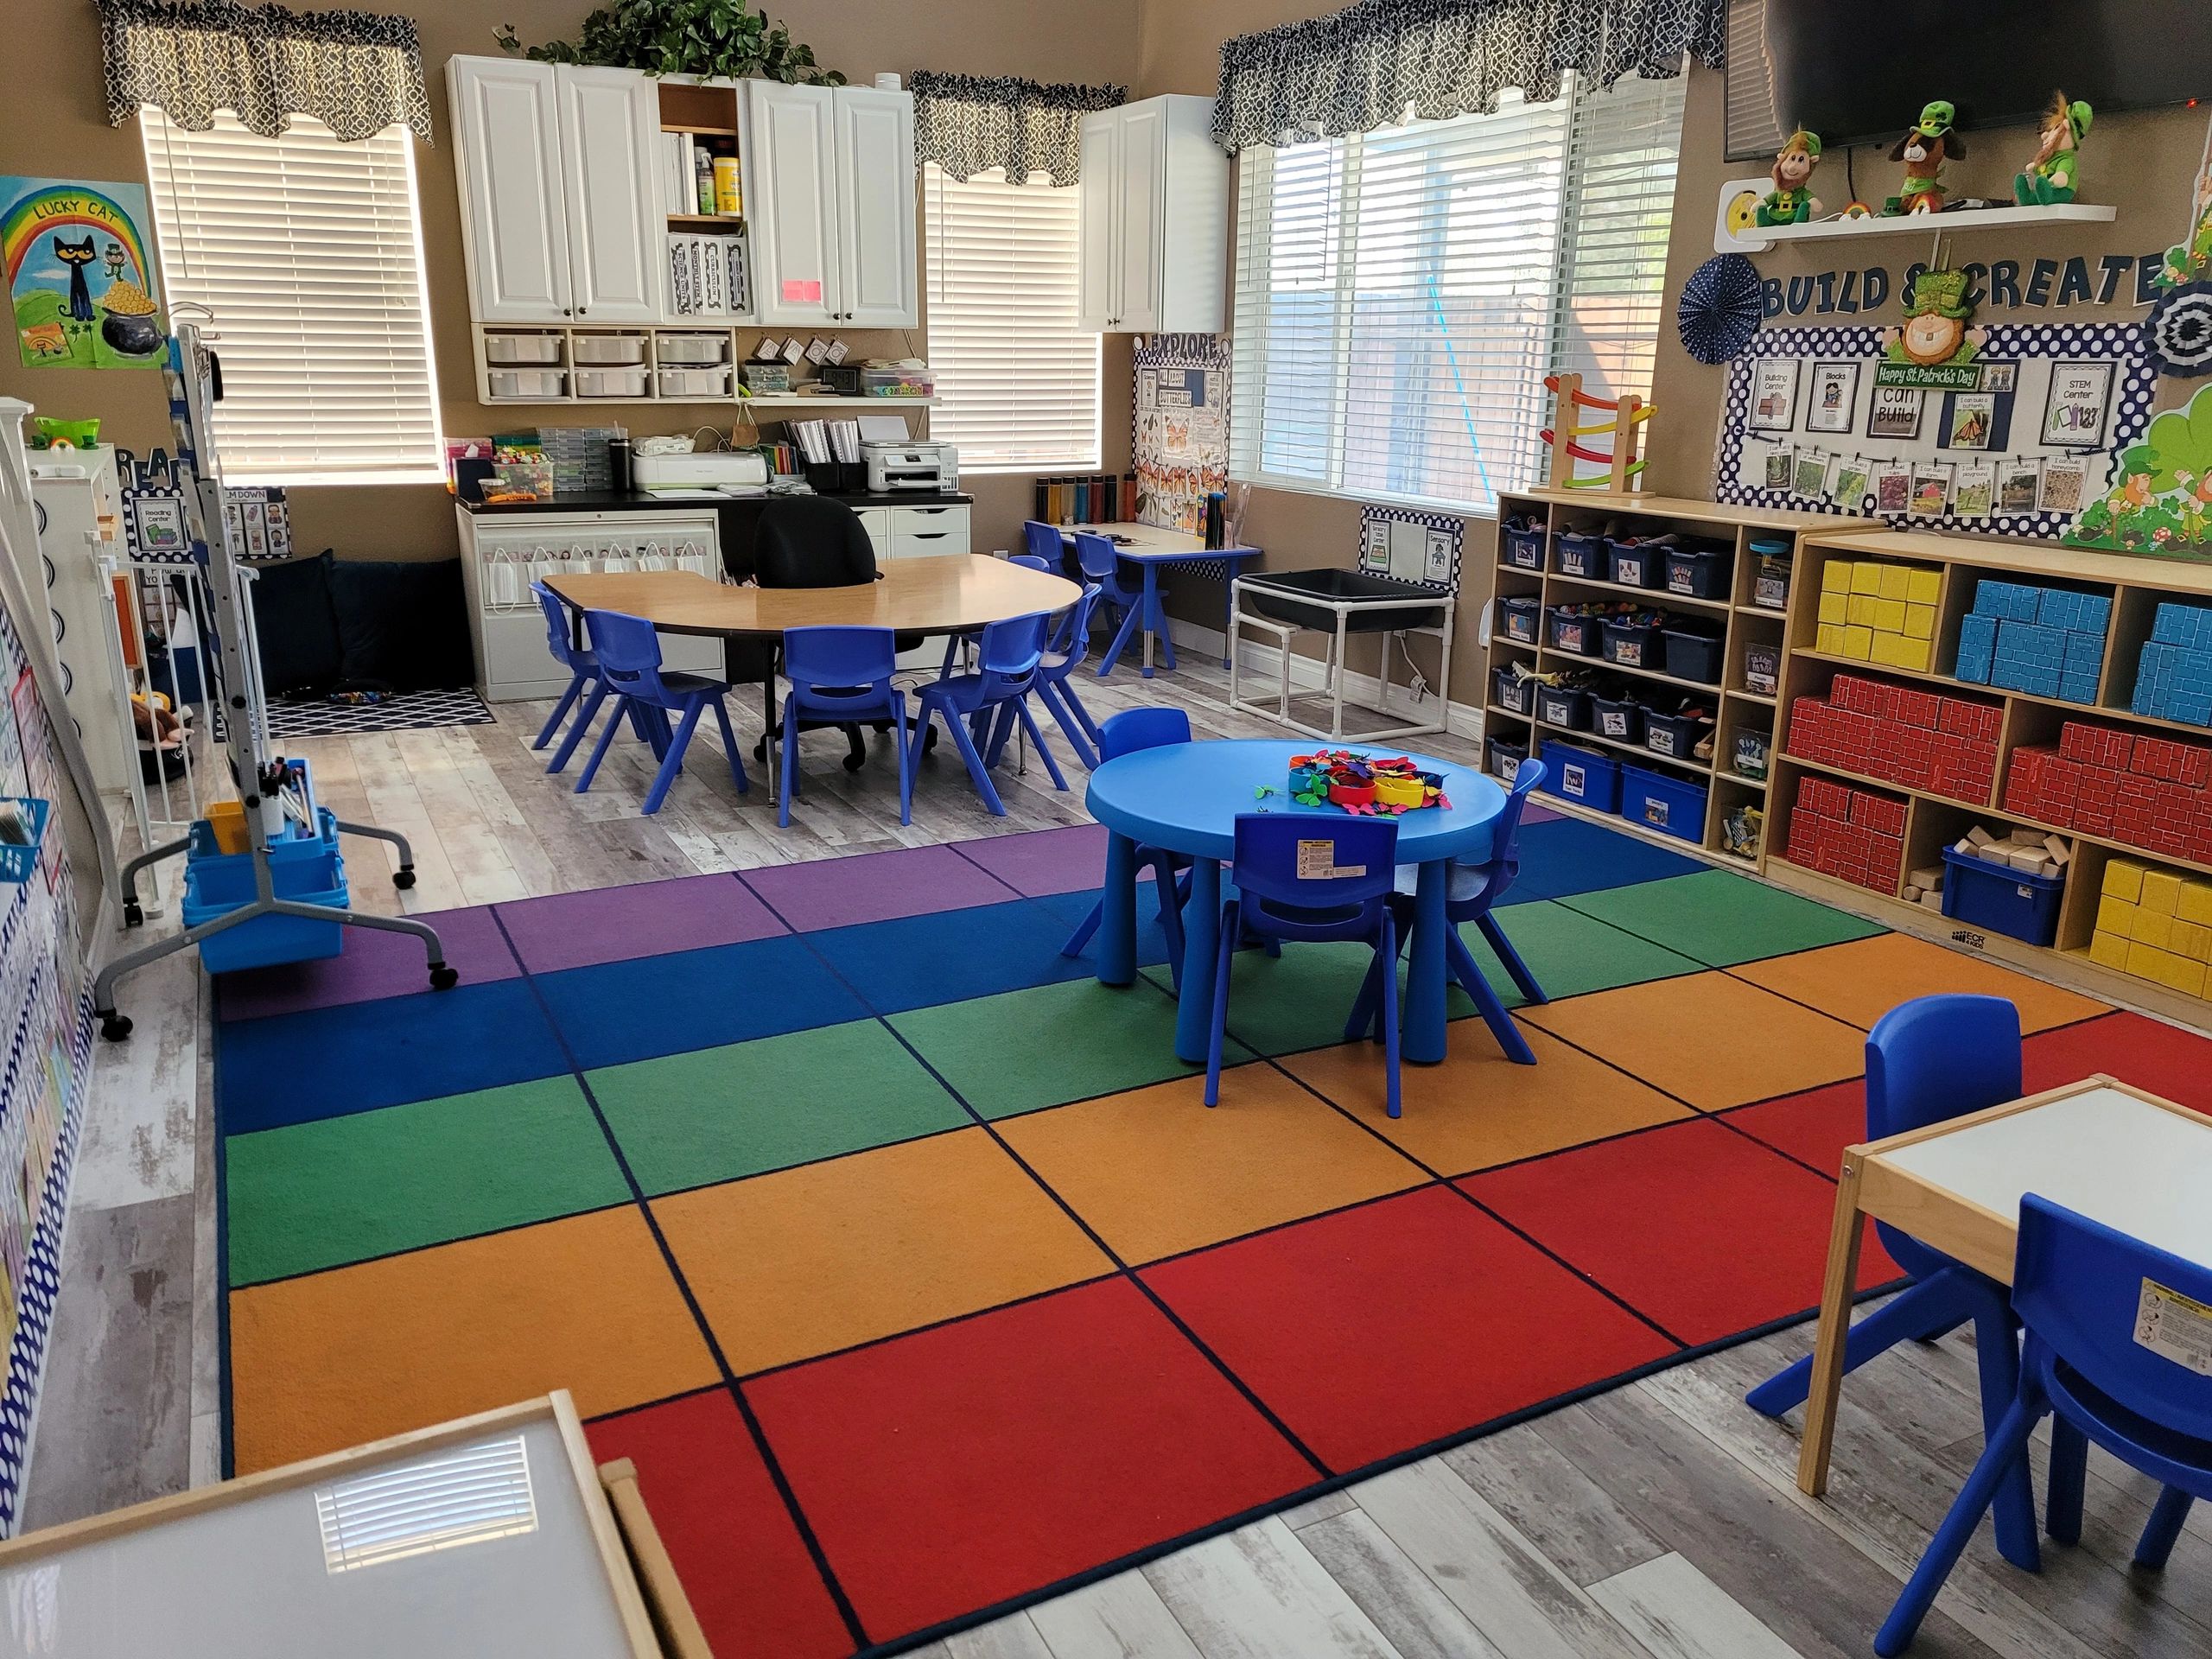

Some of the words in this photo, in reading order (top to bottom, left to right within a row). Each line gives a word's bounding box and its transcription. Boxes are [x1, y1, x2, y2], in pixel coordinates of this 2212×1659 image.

[34, 200, 79, 219] LUCKY
[88, 202, 118, 222] CAT
[1760, 267, 1889, 320] BUILD
[1961, 252, 2165, 309] CREATE
[1151, 333, 1217, 362] EXPLORE
[1169, 372, 1185, 384] ABOUT
[1878, 366, 1905, 384] Happy
[1906, 367, 1917, 383] St.
[1918, 368, 1955, 384] Patrick's
[1956, 372, 1976, 386] Day
[1160, 391, 1191, 404] BUTTERFLIES
[1430, 535, 1450, 545] Sensory
[1967, 932, 1985, 944] ECR
[1970, 941, 1983, 950] KIDS
